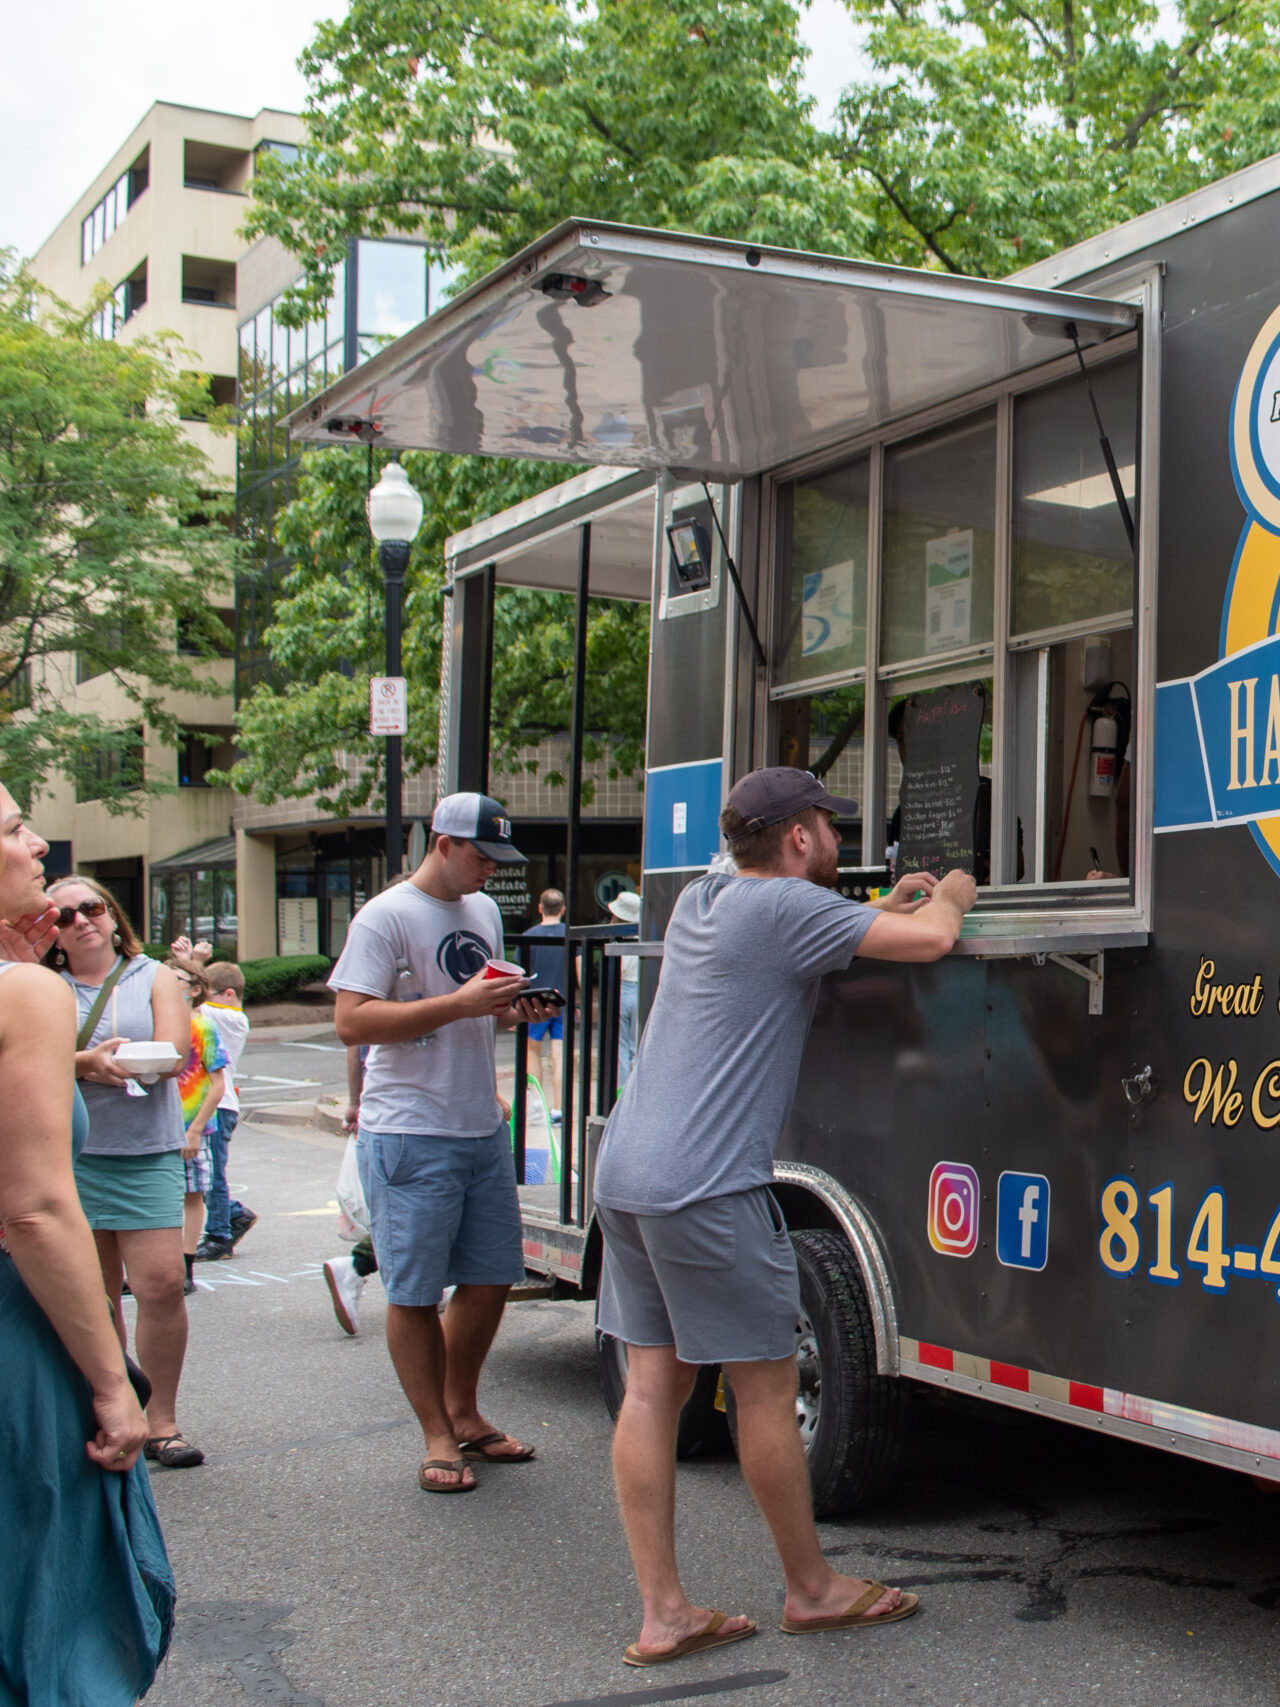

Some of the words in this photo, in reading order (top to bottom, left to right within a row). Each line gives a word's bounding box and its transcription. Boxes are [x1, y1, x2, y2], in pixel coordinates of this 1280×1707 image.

[484, 879, 527, 890] Estate
[1190, 956, 1264, 1017] Great
[1184, 1058, 1245, 1127] We
